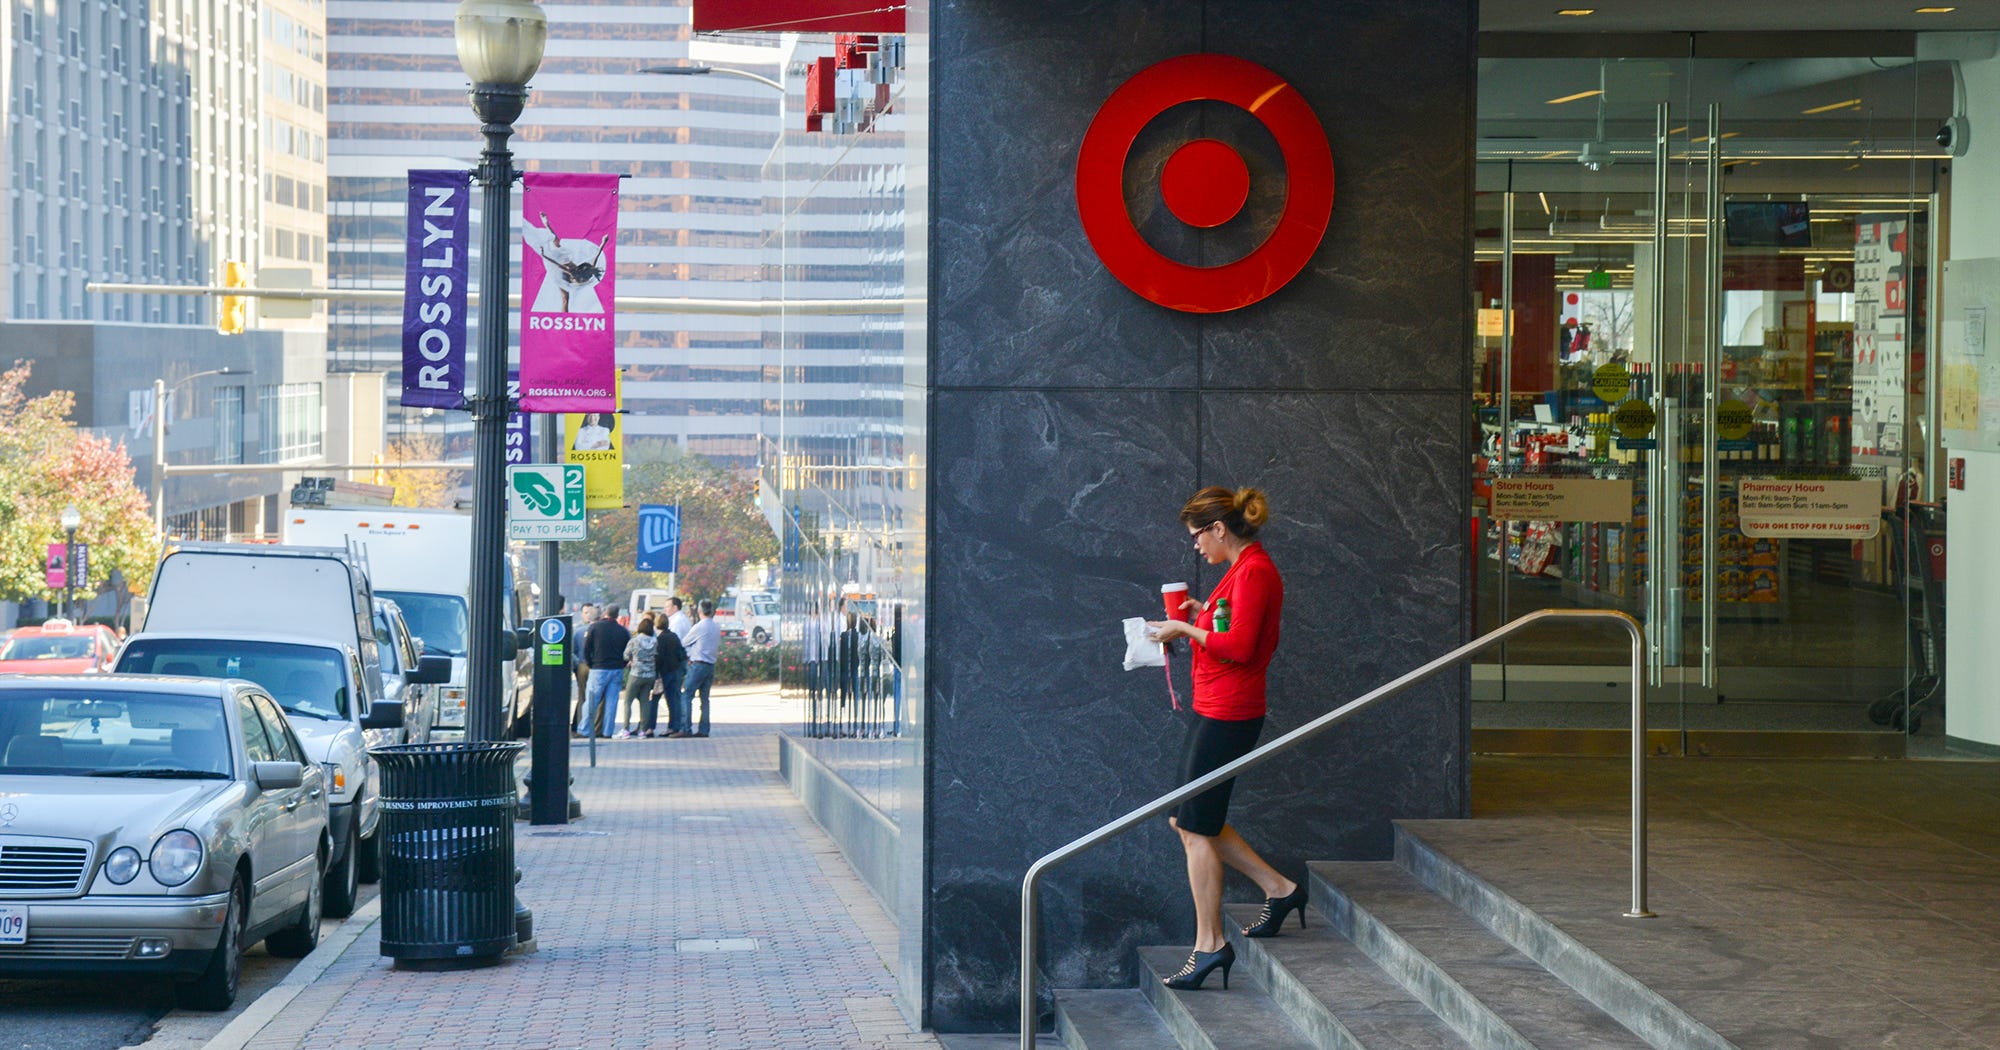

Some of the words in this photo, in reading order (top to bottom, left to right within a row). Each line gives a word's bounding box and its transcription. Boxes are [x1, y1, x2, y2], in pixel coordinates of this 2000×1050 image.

[418, 187, 455, 390] ROSSLYN
[529, 316, 605, 331] ROSSLYN
[528, 388, 606, 397] ROSSLYNVA.ORG
[571, 453, 616, 461] ROSSLYN
[566, 470, 582, 488] 2
[1496, 481, 1522, 491] Store
[1525, 482, 1554, 491] Hours
[1743, 483, 1792, 493] Pharmacy
[1795, 484, 1825, 492] Hours
[513, 525, 531, 534] PAY
[537, 525, 550, 534] TO
[555, 525, 580, 534] PARK
[417, 799, 478, 810] IMPROVEMENT
[0, 916, 23, 934] 09
